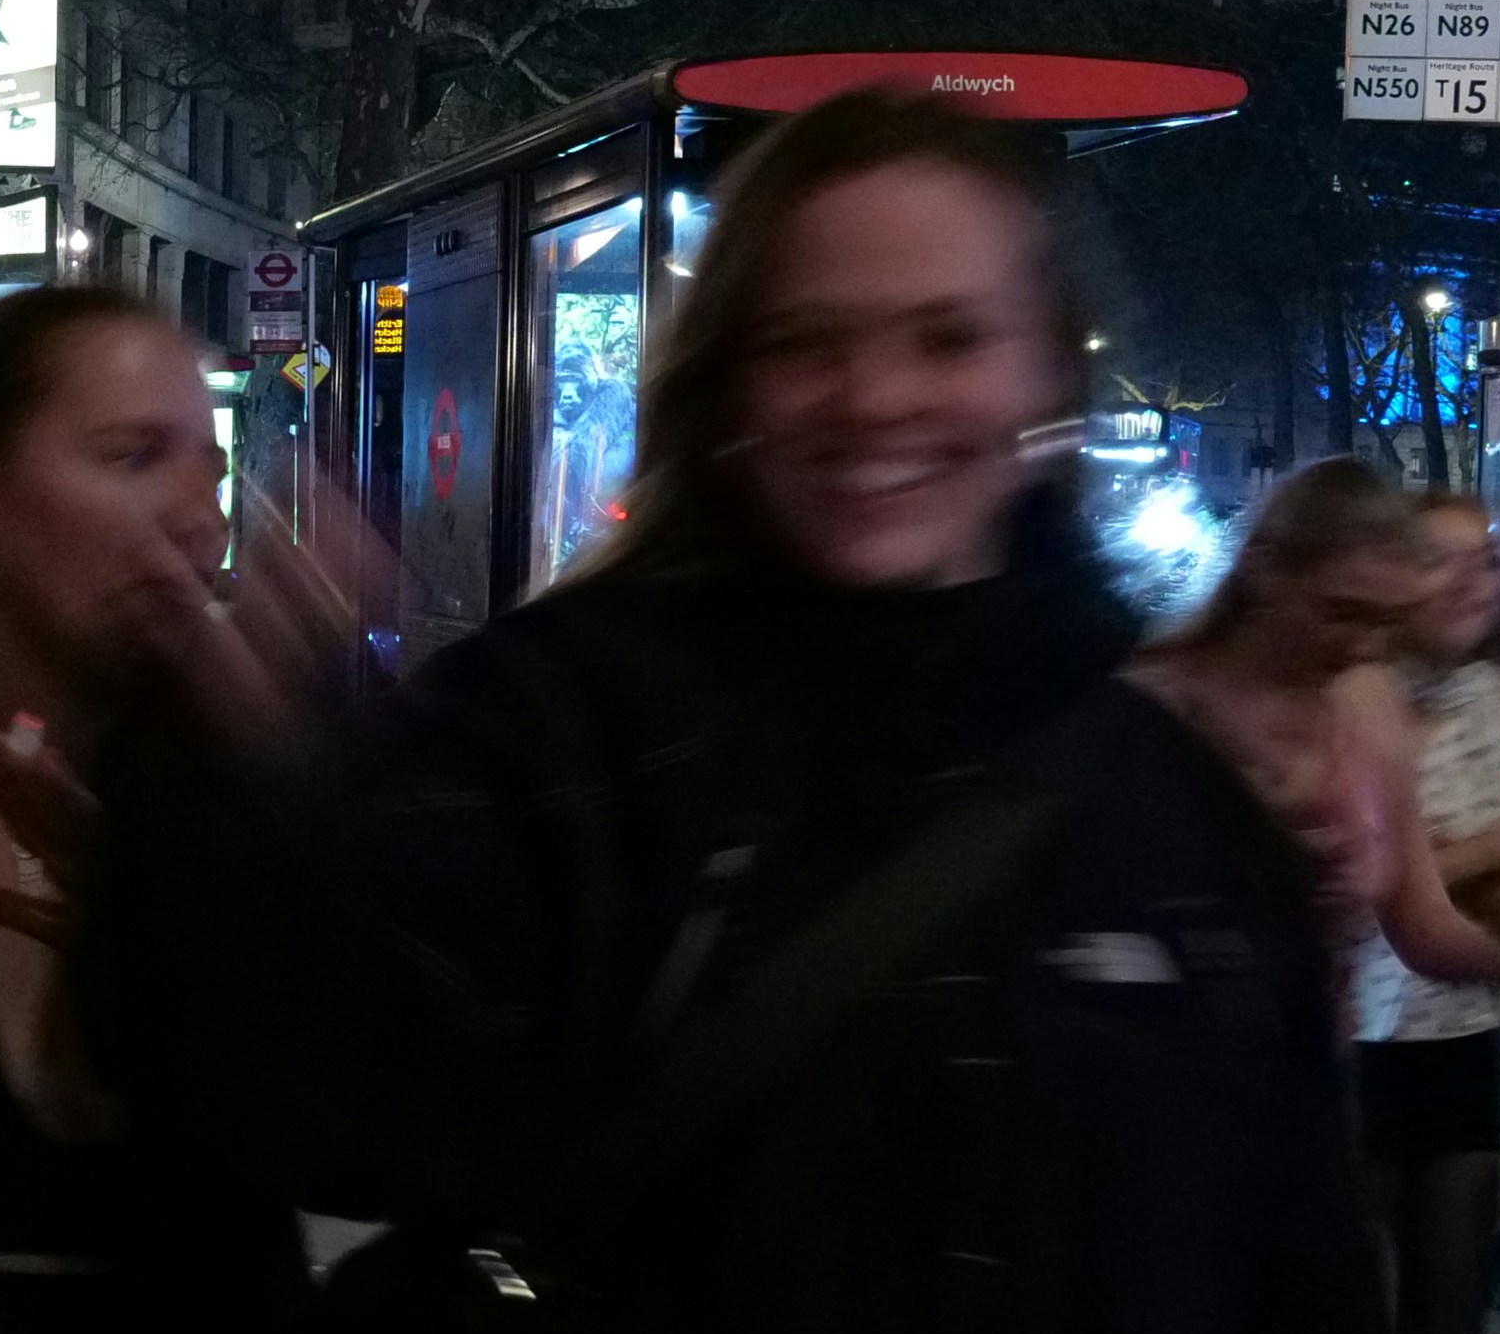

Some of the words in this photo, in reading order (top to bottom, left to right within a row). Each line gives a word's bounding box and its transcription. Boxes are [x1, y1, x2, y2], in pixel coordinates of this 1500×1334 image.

[1361, 14, 1415, 36] N26
[1438, 15, 1489, 37] N89
[1430, 62, 1466, 72] Heritage
[1469, 63, 1495, 71] Route
[931, 74, 1016, 97] Aldwych
[1353, 77, 1419, 99] N550
